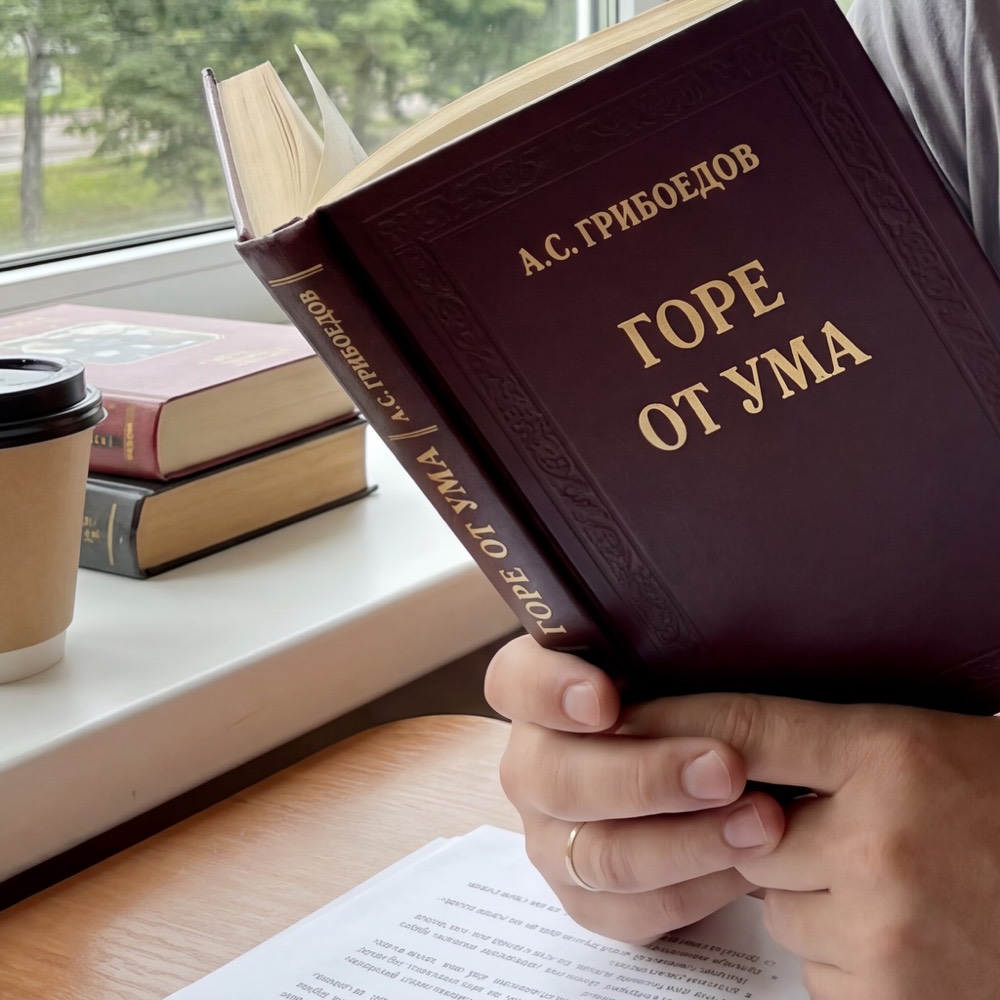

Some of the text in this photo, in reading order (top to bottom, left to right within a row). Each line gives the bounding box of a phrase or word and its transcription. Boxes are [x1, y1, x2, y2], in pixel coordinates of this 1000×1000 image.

[517, 143, 760, 277] А.С. ГРИБОЕДОВ
[299, 288, 410, 421] А.С. ГРИБОЕДОВ
[617, 259, 786, 369] ГОРЕ
[638, 321, 873, 452] ОТ УМА
[416, 446, 568, 636] ГОРЕ ОТ УМА
